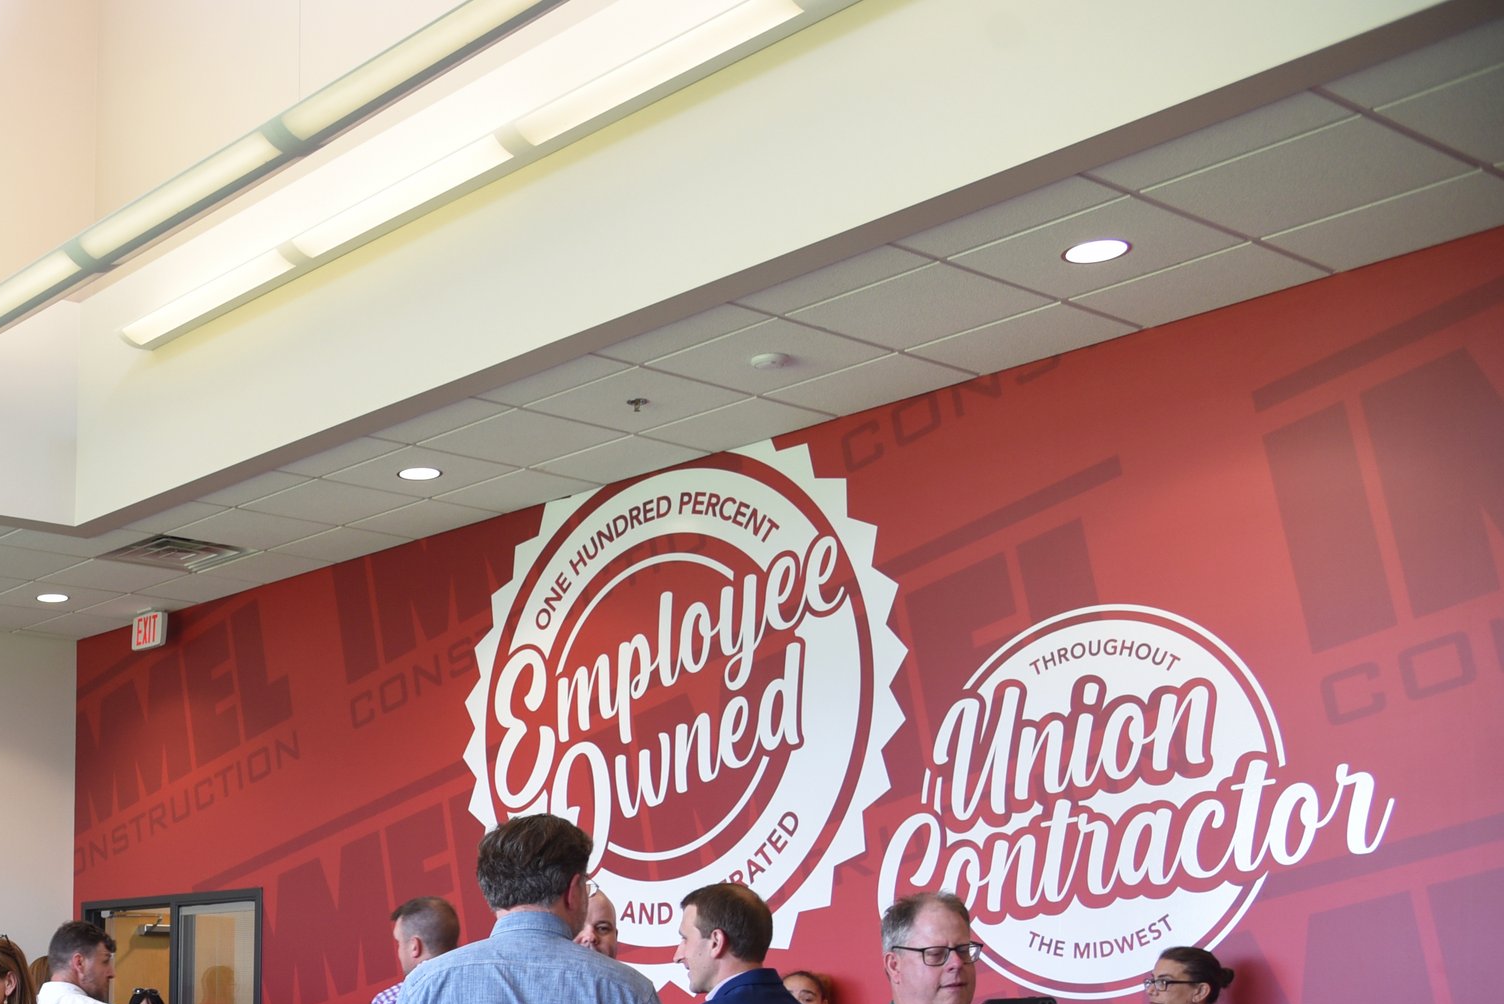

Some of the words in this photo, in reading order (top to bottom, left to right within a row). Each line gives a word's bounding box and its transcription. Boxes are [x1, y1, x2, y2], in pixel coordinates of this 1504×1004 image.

[136, 613, 158, 646] EXIT
[535, 572, 572, 630] ONE
[568, 494, 672, 577] HUNDRED
[678, 491, 781, 543] PERCENT
[494, 535, 846, 800] Employee
[1028, 638, 1183, 677] THROUGHOUT
[550, 642, 802, 876] Owned
[932, 682, 1210, 821] Union
[619, 900, 674, 926] AND
[718, 810, 800, 889] RATED
[877, 758, 1395, 922] Contractor
[1026, 930, 1065, 960] THE
[1073, 914, 1173, 960] MIDWEST
